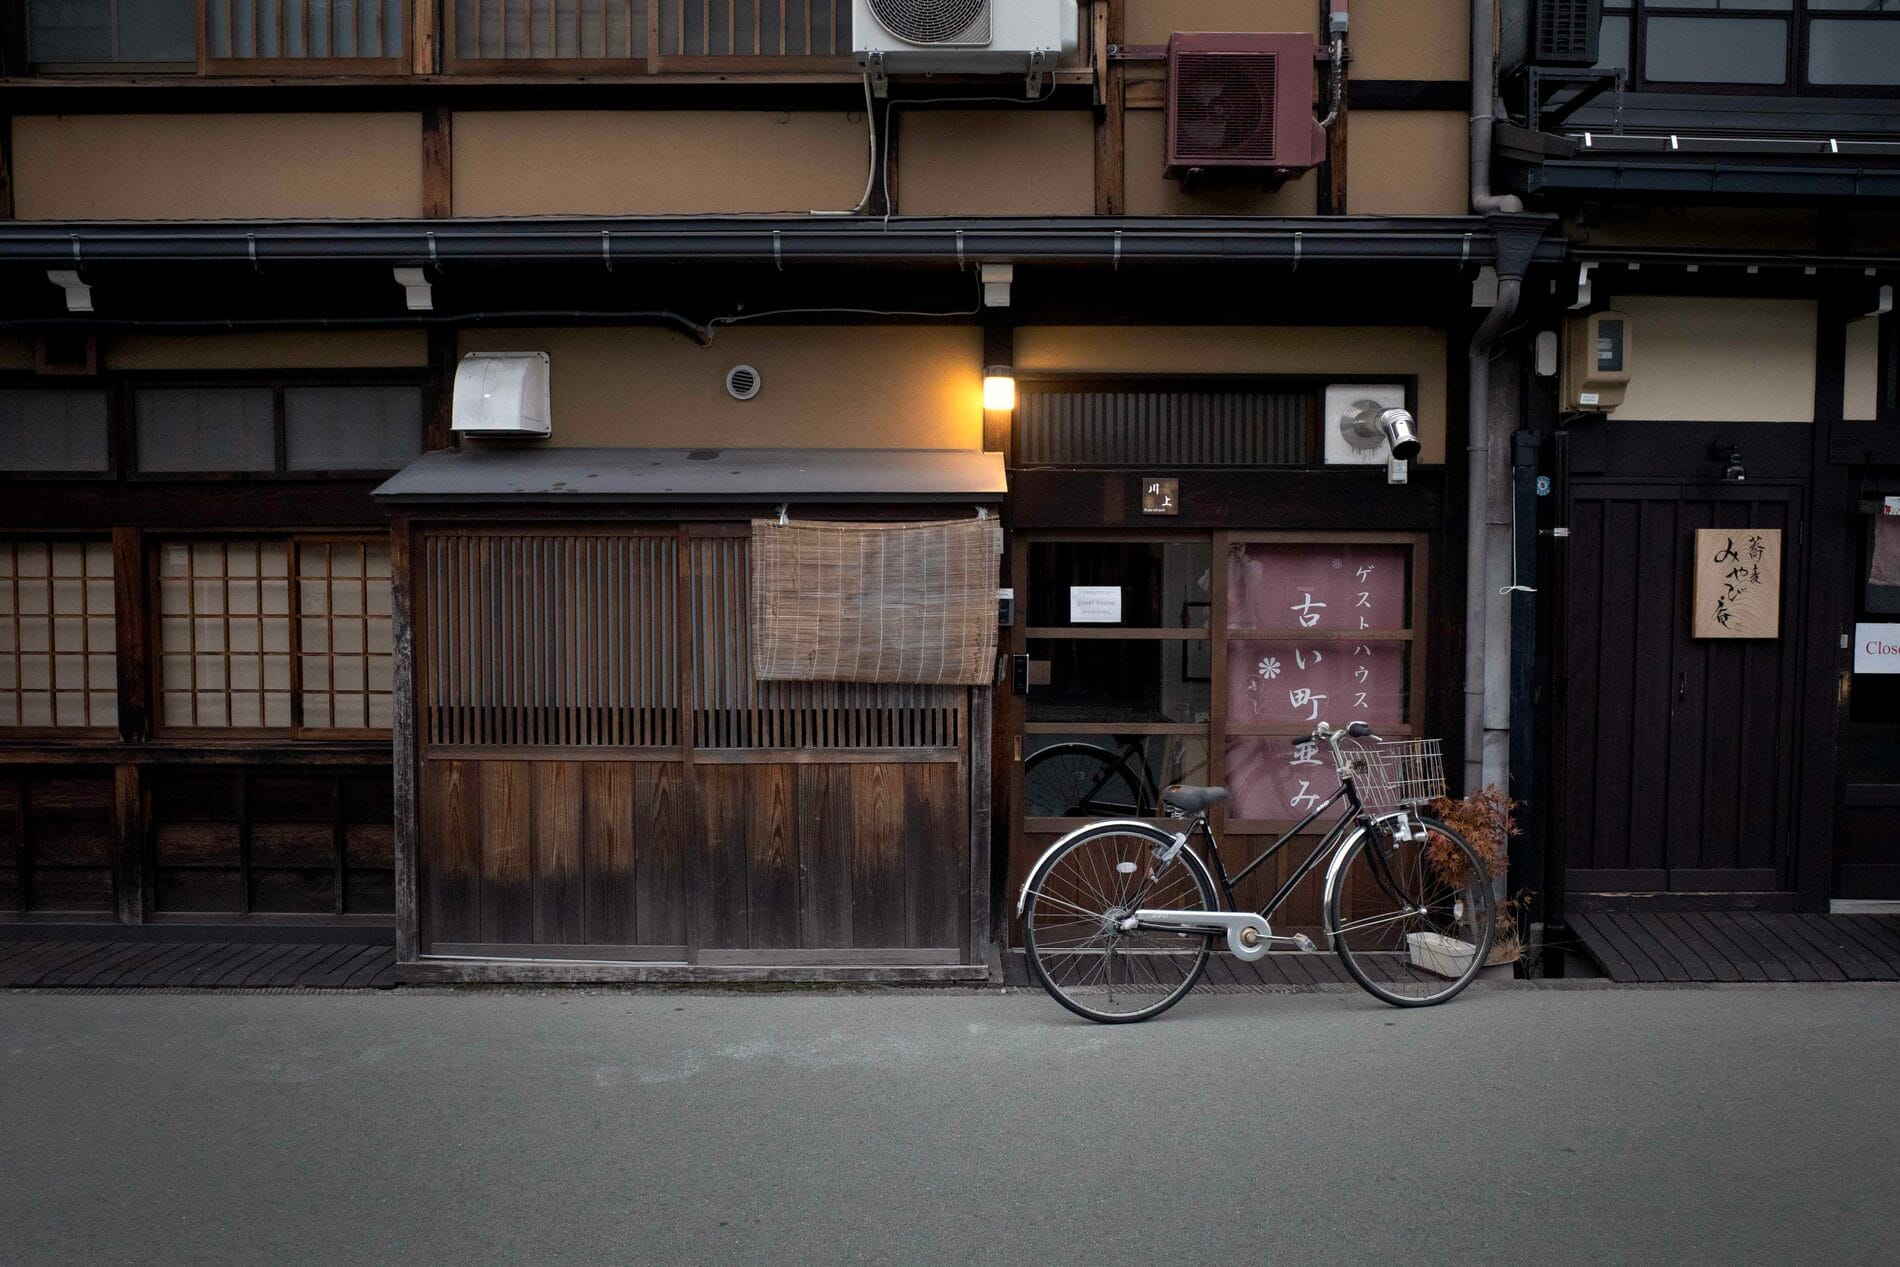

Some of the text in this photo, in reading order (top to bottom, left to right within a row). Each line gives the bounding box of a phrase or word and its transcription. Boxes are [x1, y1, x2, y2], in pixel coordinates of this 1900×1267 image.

[1148, 483, 1172, 507] 川上
[1289, 592, 1327, 811] 古い町並み
[1353, 565, 1375, 709] ゲストハウス
